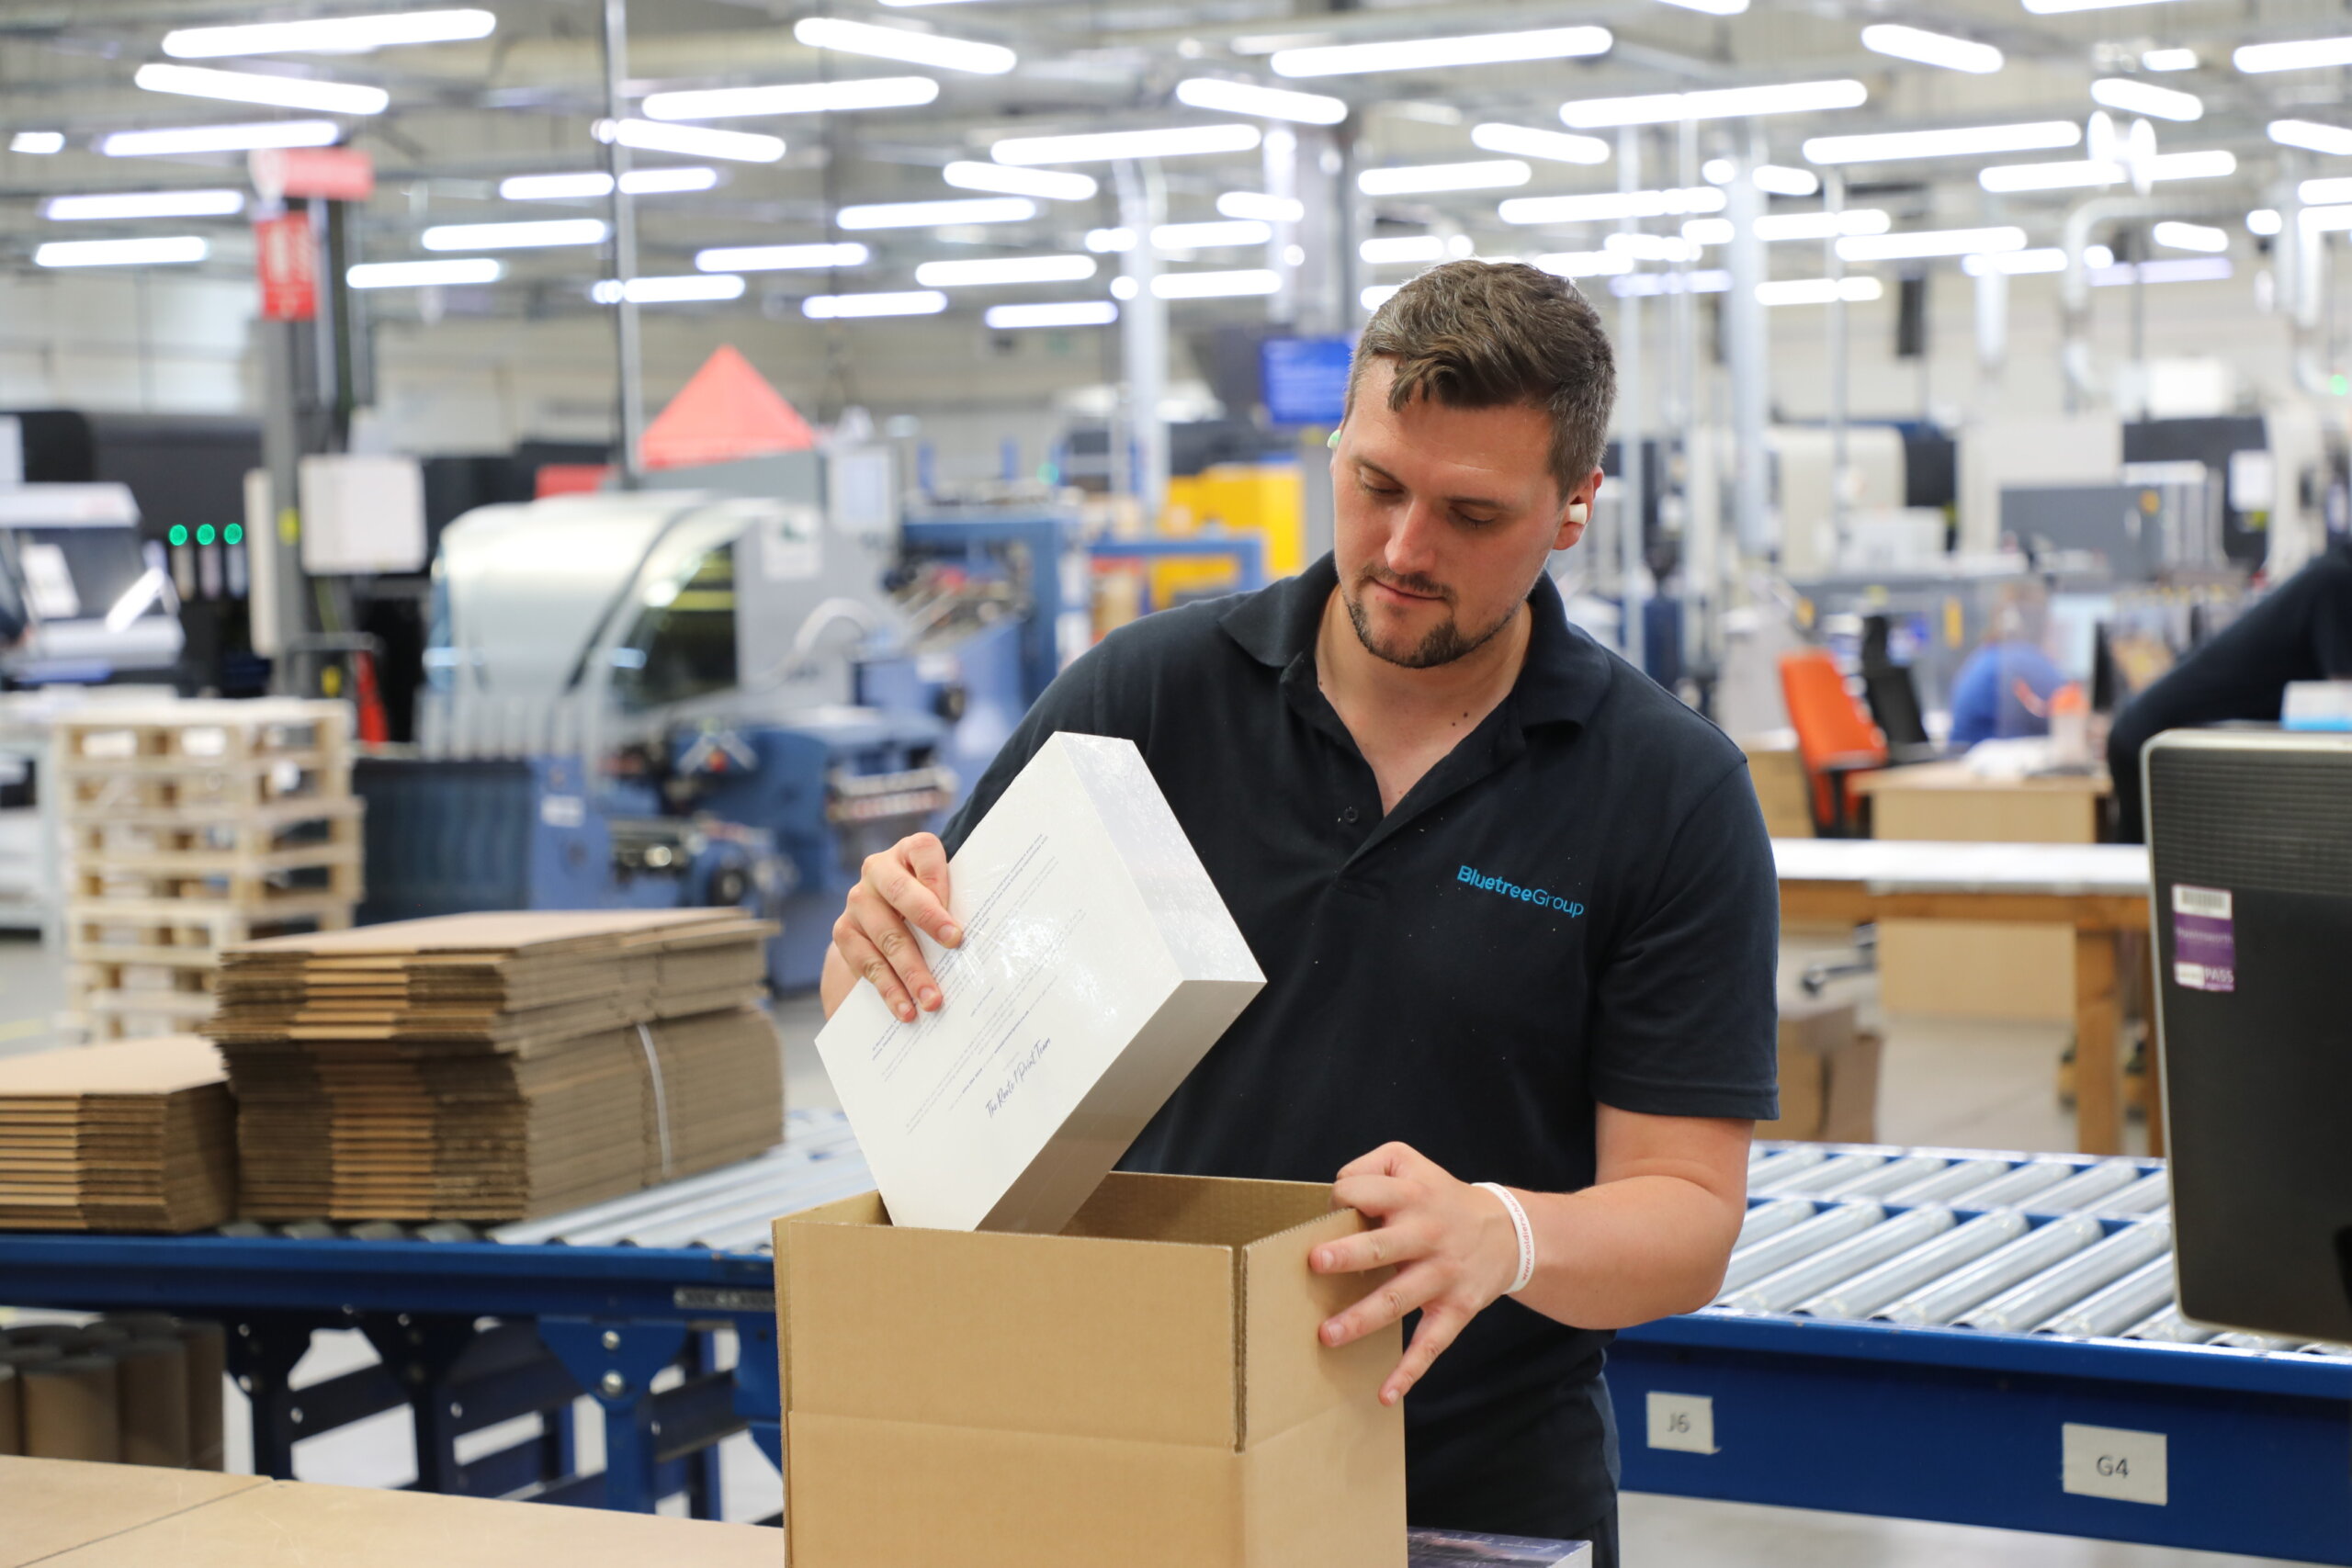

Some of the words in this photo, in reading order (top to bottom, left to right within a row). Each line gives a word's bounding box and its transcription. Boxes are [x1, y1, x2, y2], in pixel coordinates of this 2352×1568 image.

[1457, 865, 1585, 919] BluetreeGroup
[2205, 966, 2234, 983] PASS
[985, 1100, 998, 1118] The
[997, 1079, 1015, 1108] Route
[1017, 1050, 1036, 1082] Print
[1034, 1037, 1051, 1058] Team
[1667, 1413, 1690, 1434] J6
[2096, 1454, 2130, 1479] G4
